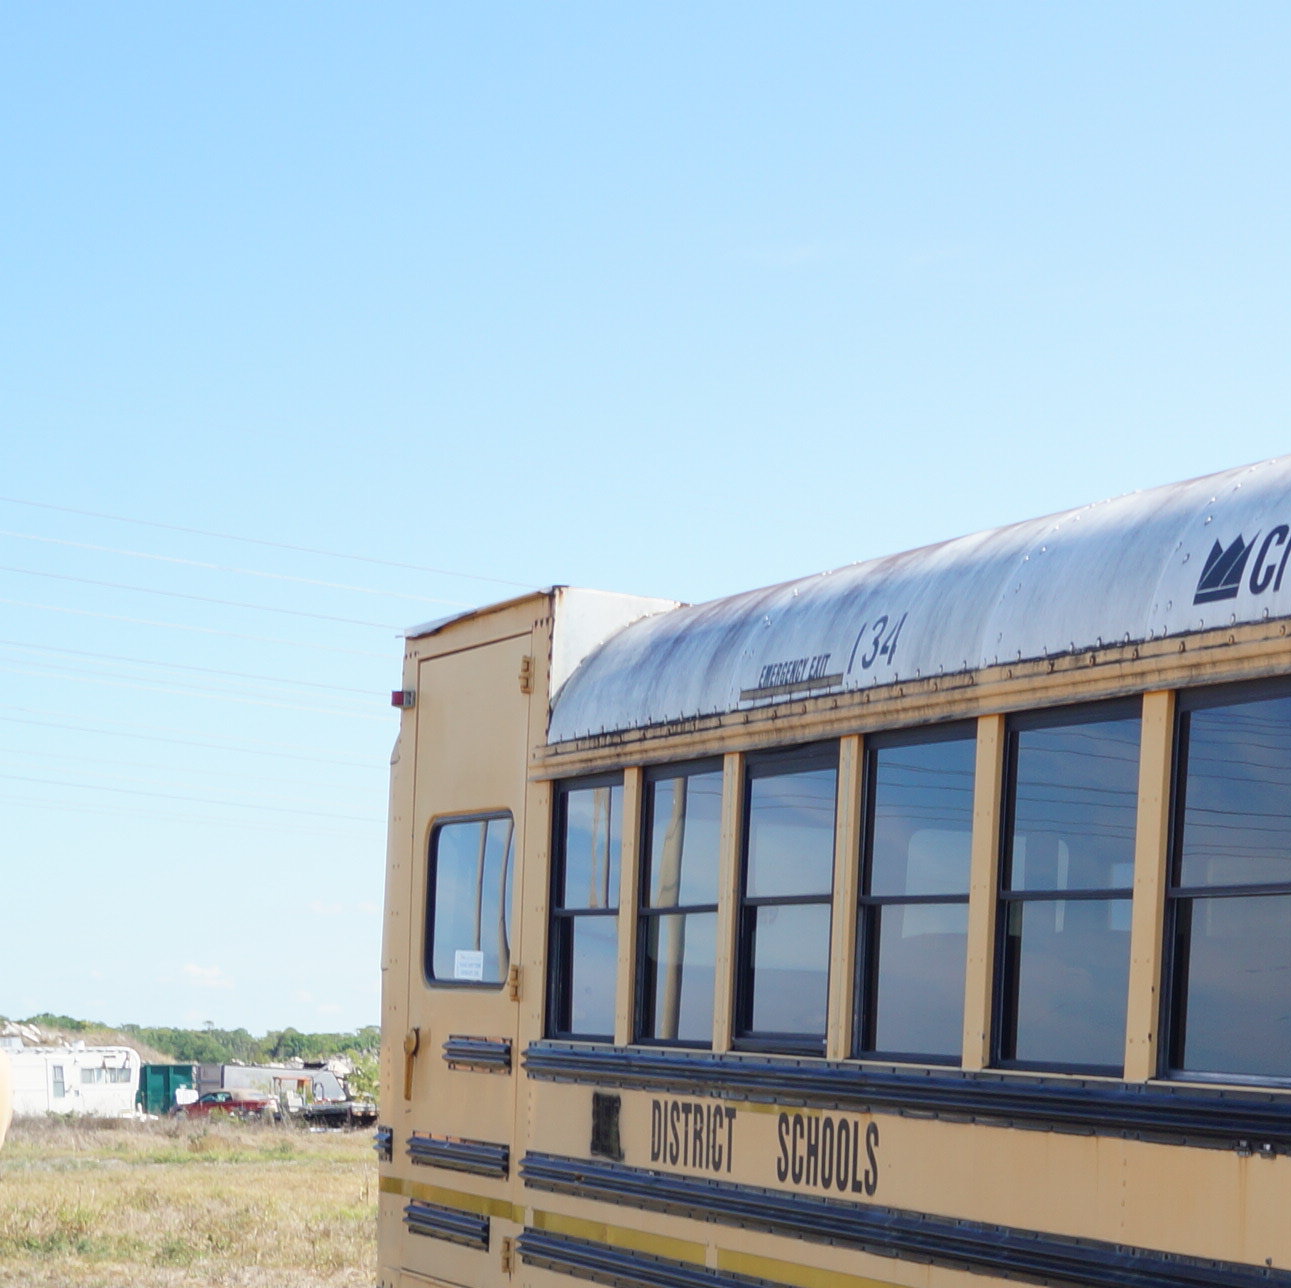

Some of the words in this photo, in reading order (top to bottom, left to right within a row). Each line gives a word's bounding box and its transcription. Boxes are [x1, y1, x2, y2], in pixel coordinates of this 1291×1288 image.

[758, 656, 810, 689] EMERGENCY
[808, 652, 832, 682] EXIT
[847, 611, 909, 675] 134
[651, 1099, 737, 1173] DISTRICT
[776, 1111, 880, 1197] SCHOOLS
